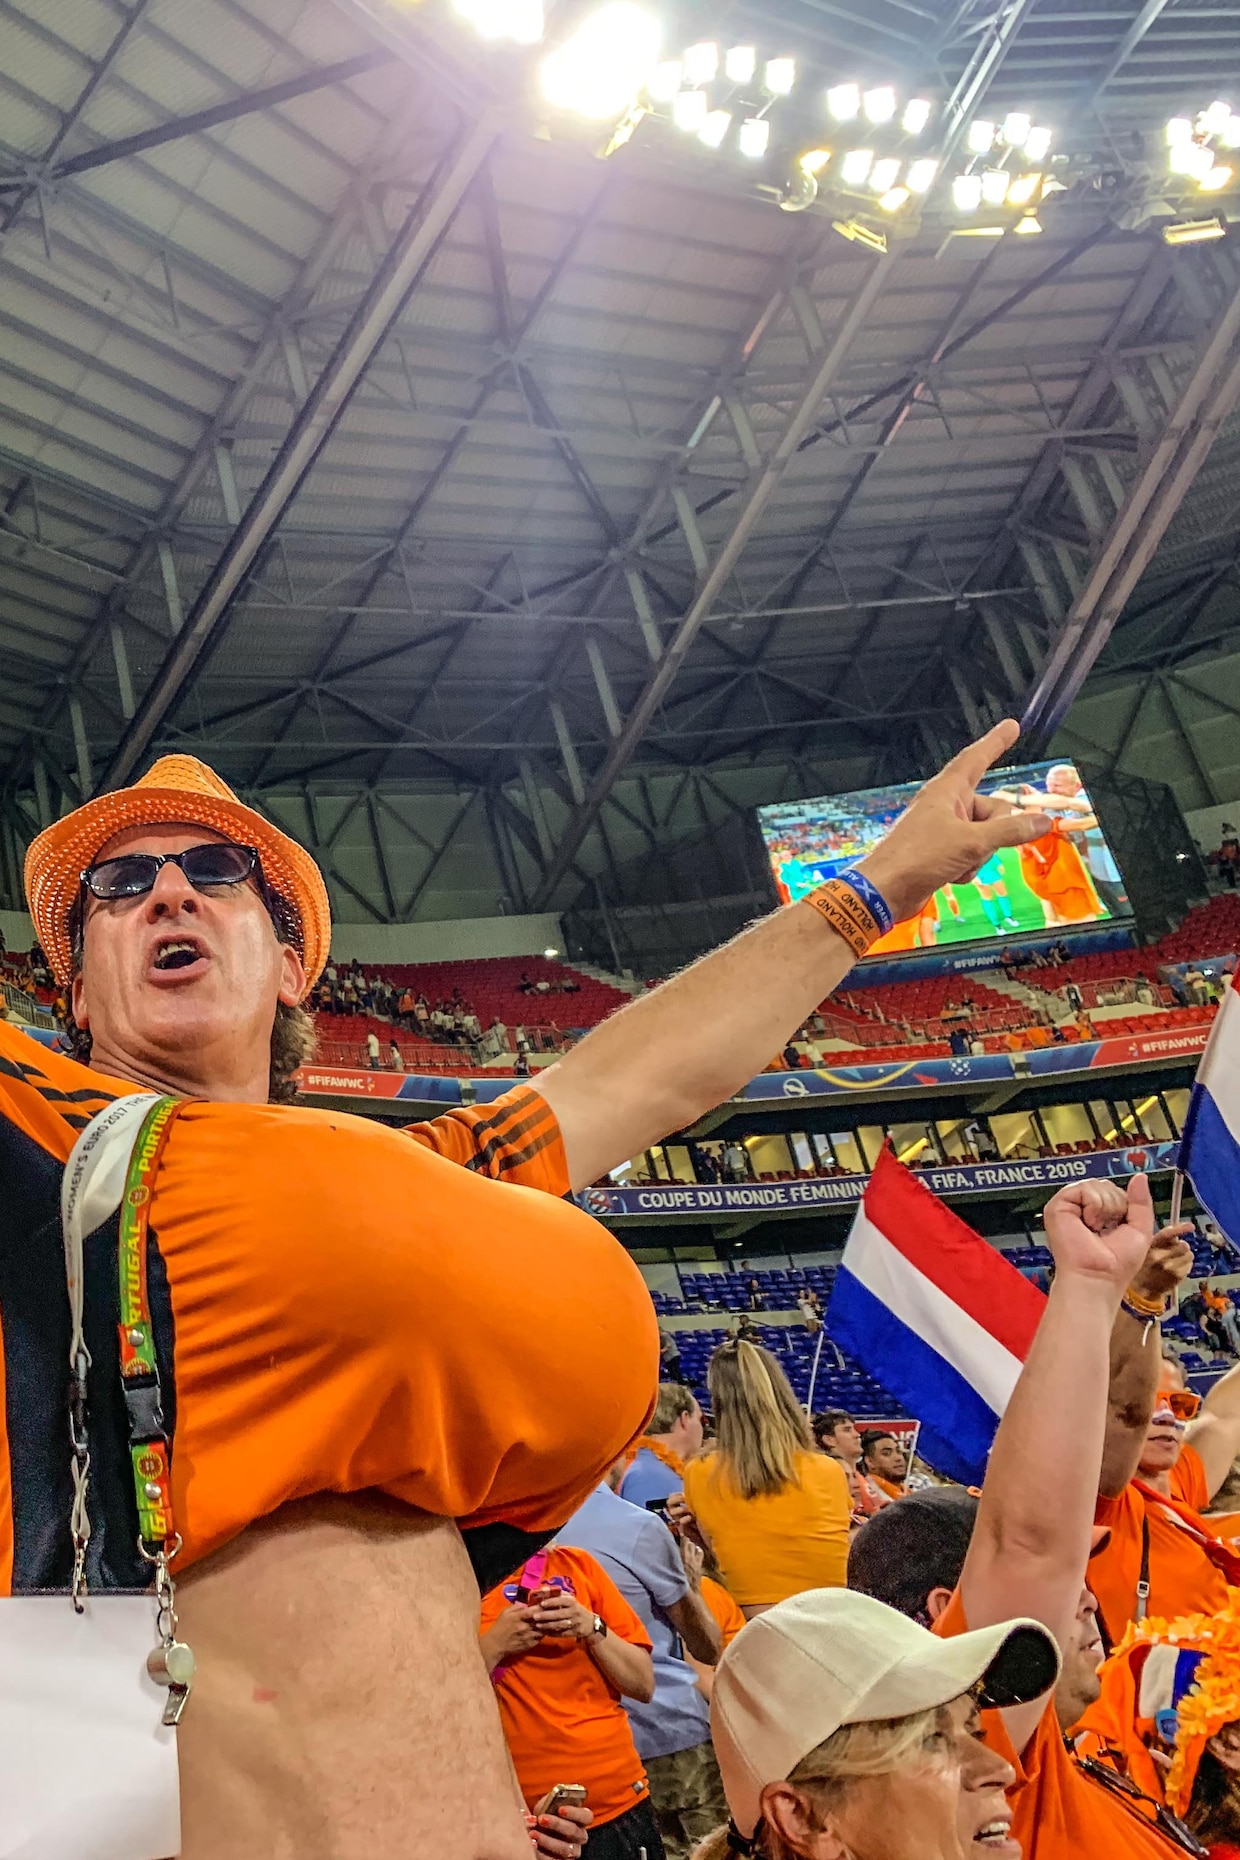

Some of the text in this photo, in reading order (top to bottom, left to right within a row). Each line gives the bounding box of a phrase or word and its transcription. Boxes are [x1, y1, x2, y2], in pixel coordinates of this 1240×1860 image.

[816, 898, 856, 936] HOLLAND
[841, 893, 874, 931] HOLLAND
[1142, 1034, 1208, 1053] #FIFAWWC
[307, 1075, 364, 1089] #FIFAWWC
[67, 1154, 88, 1221] WOMEN'S
[83, 1124, 109, 1152] EURO
[103, 1107, 128, 1125] 2017
[638, 1191, 694, 1209] COUPE
[699, 1190, 723, 1207] DU
[726, 1188, 786, 1206] MONDE
[932, 1172, 974, 1190] FIFA,
[976, 1165, 1043, 1186] FRANCE
